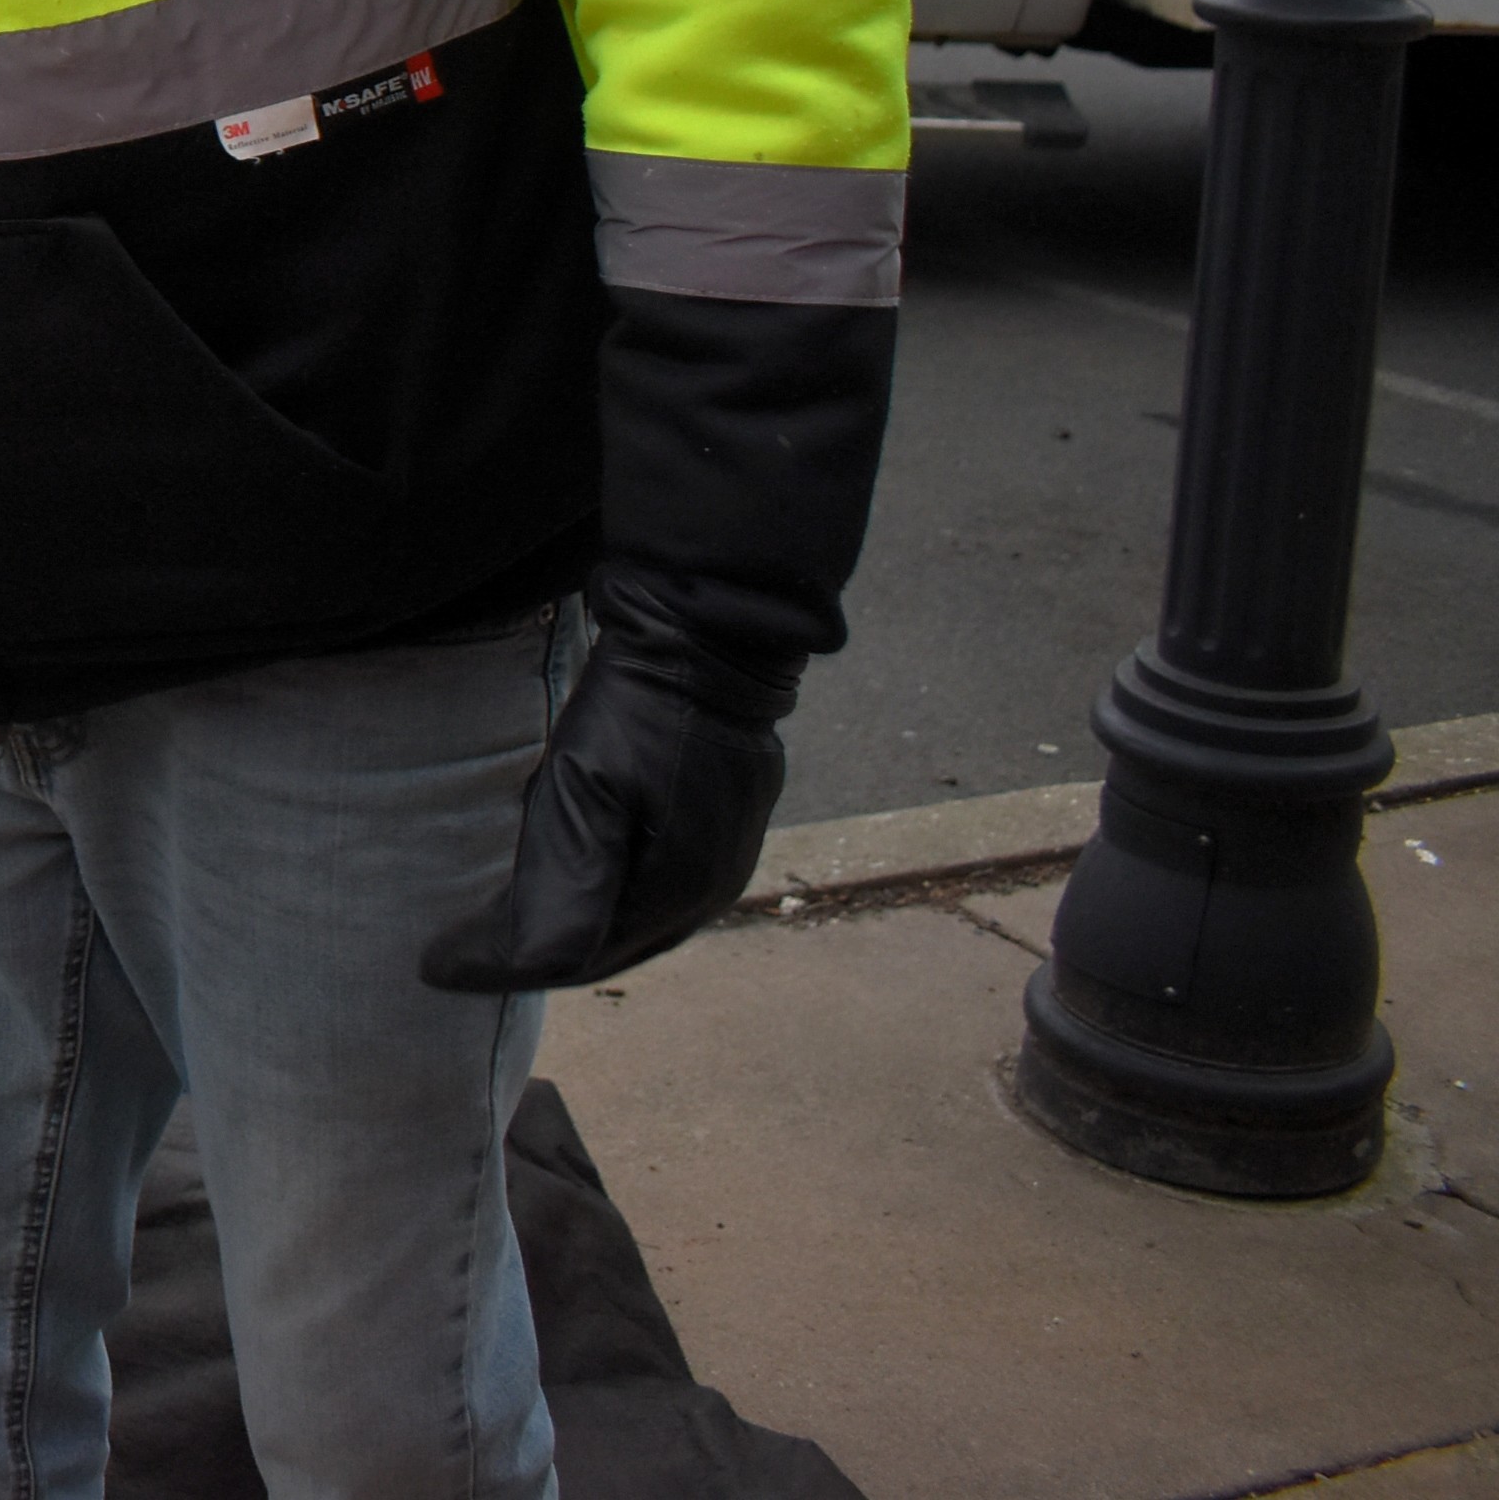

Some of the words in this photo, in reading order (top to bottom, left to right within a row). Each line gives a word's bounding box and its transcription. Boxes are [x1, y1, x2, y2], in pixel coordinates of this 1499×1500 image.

[223, 120, 250, 140] 3M
[227, 135, 270, 151] Reflective
[272, 123, 308, 140] Material
